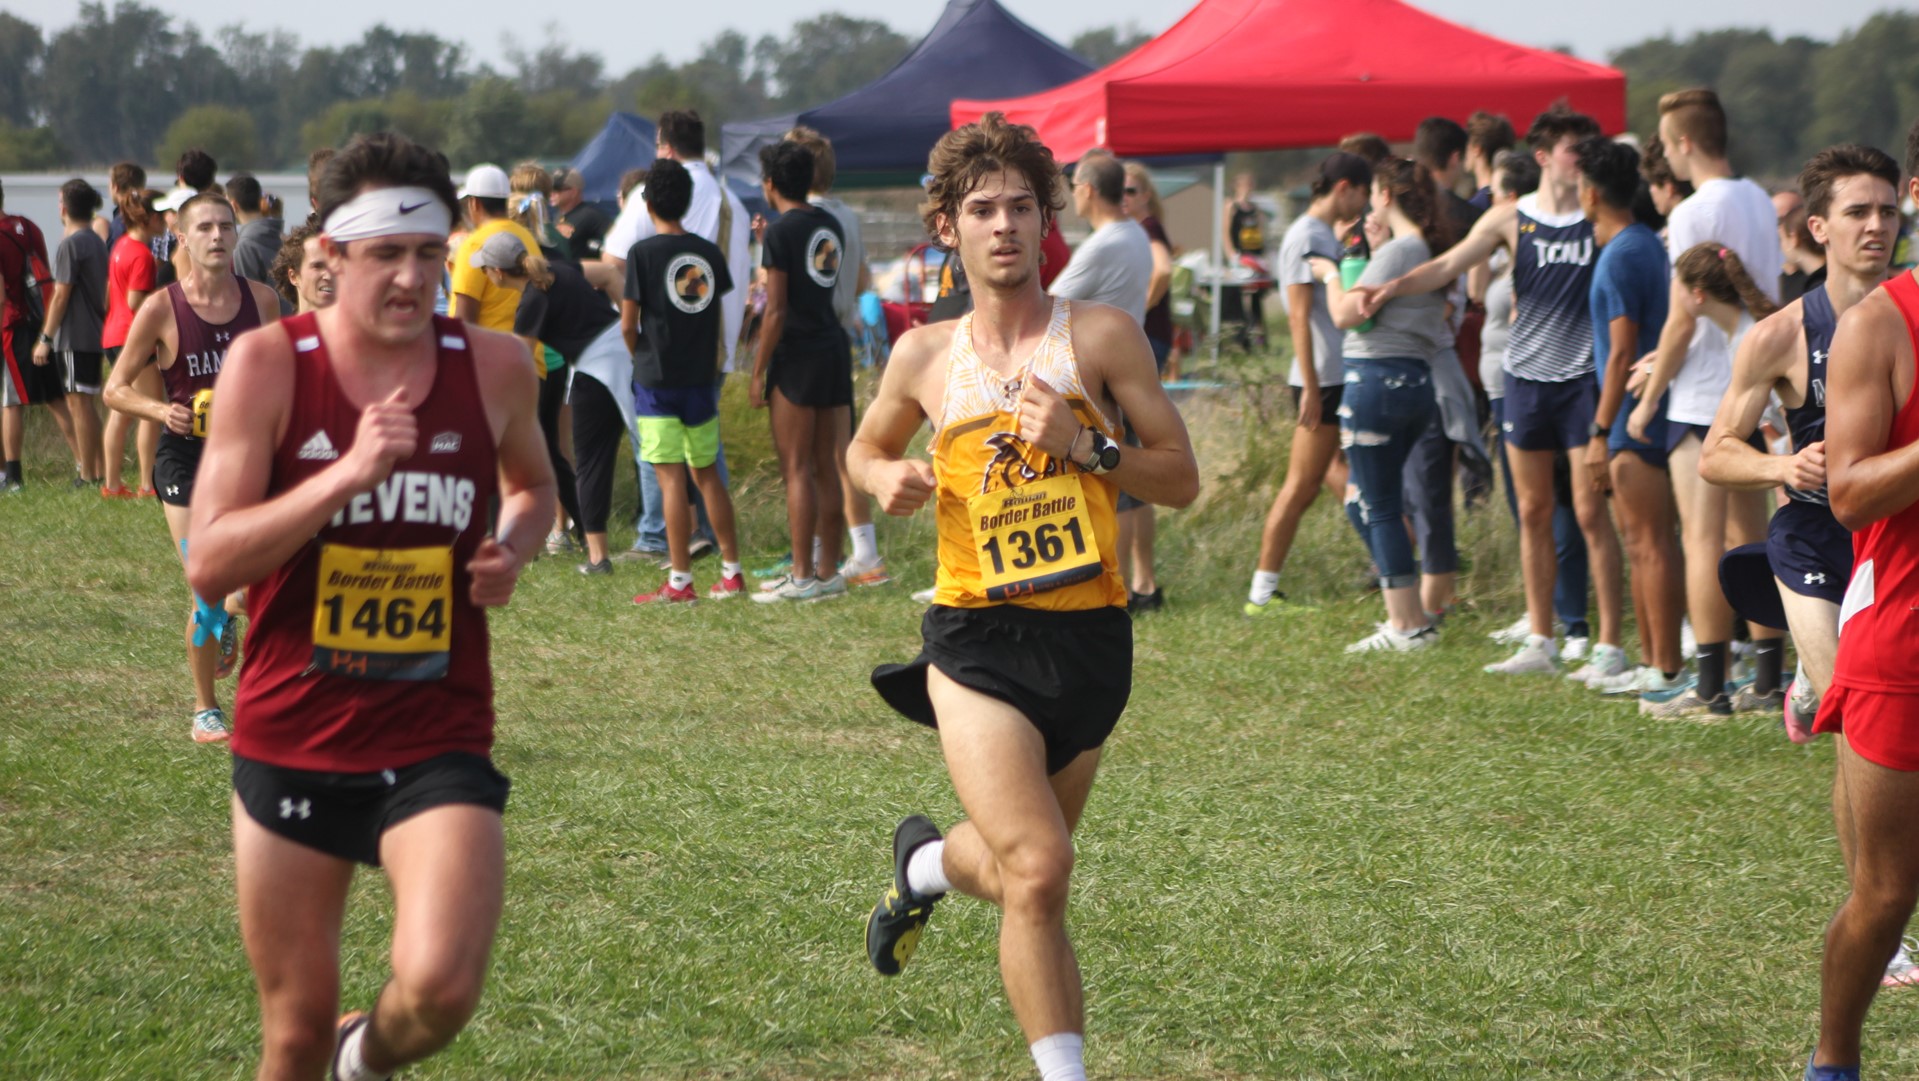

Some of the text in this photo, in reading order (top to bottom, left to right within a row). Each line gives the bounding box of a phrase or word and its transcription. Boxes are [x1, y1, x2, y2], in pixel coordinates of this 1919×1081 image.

[980, 495, 1076, 532] Border Battle
[982, 516, 1087, 576] 1361
[328, 569, 445, 591] Border Battle
[323, 593, 448, 641] 1464
